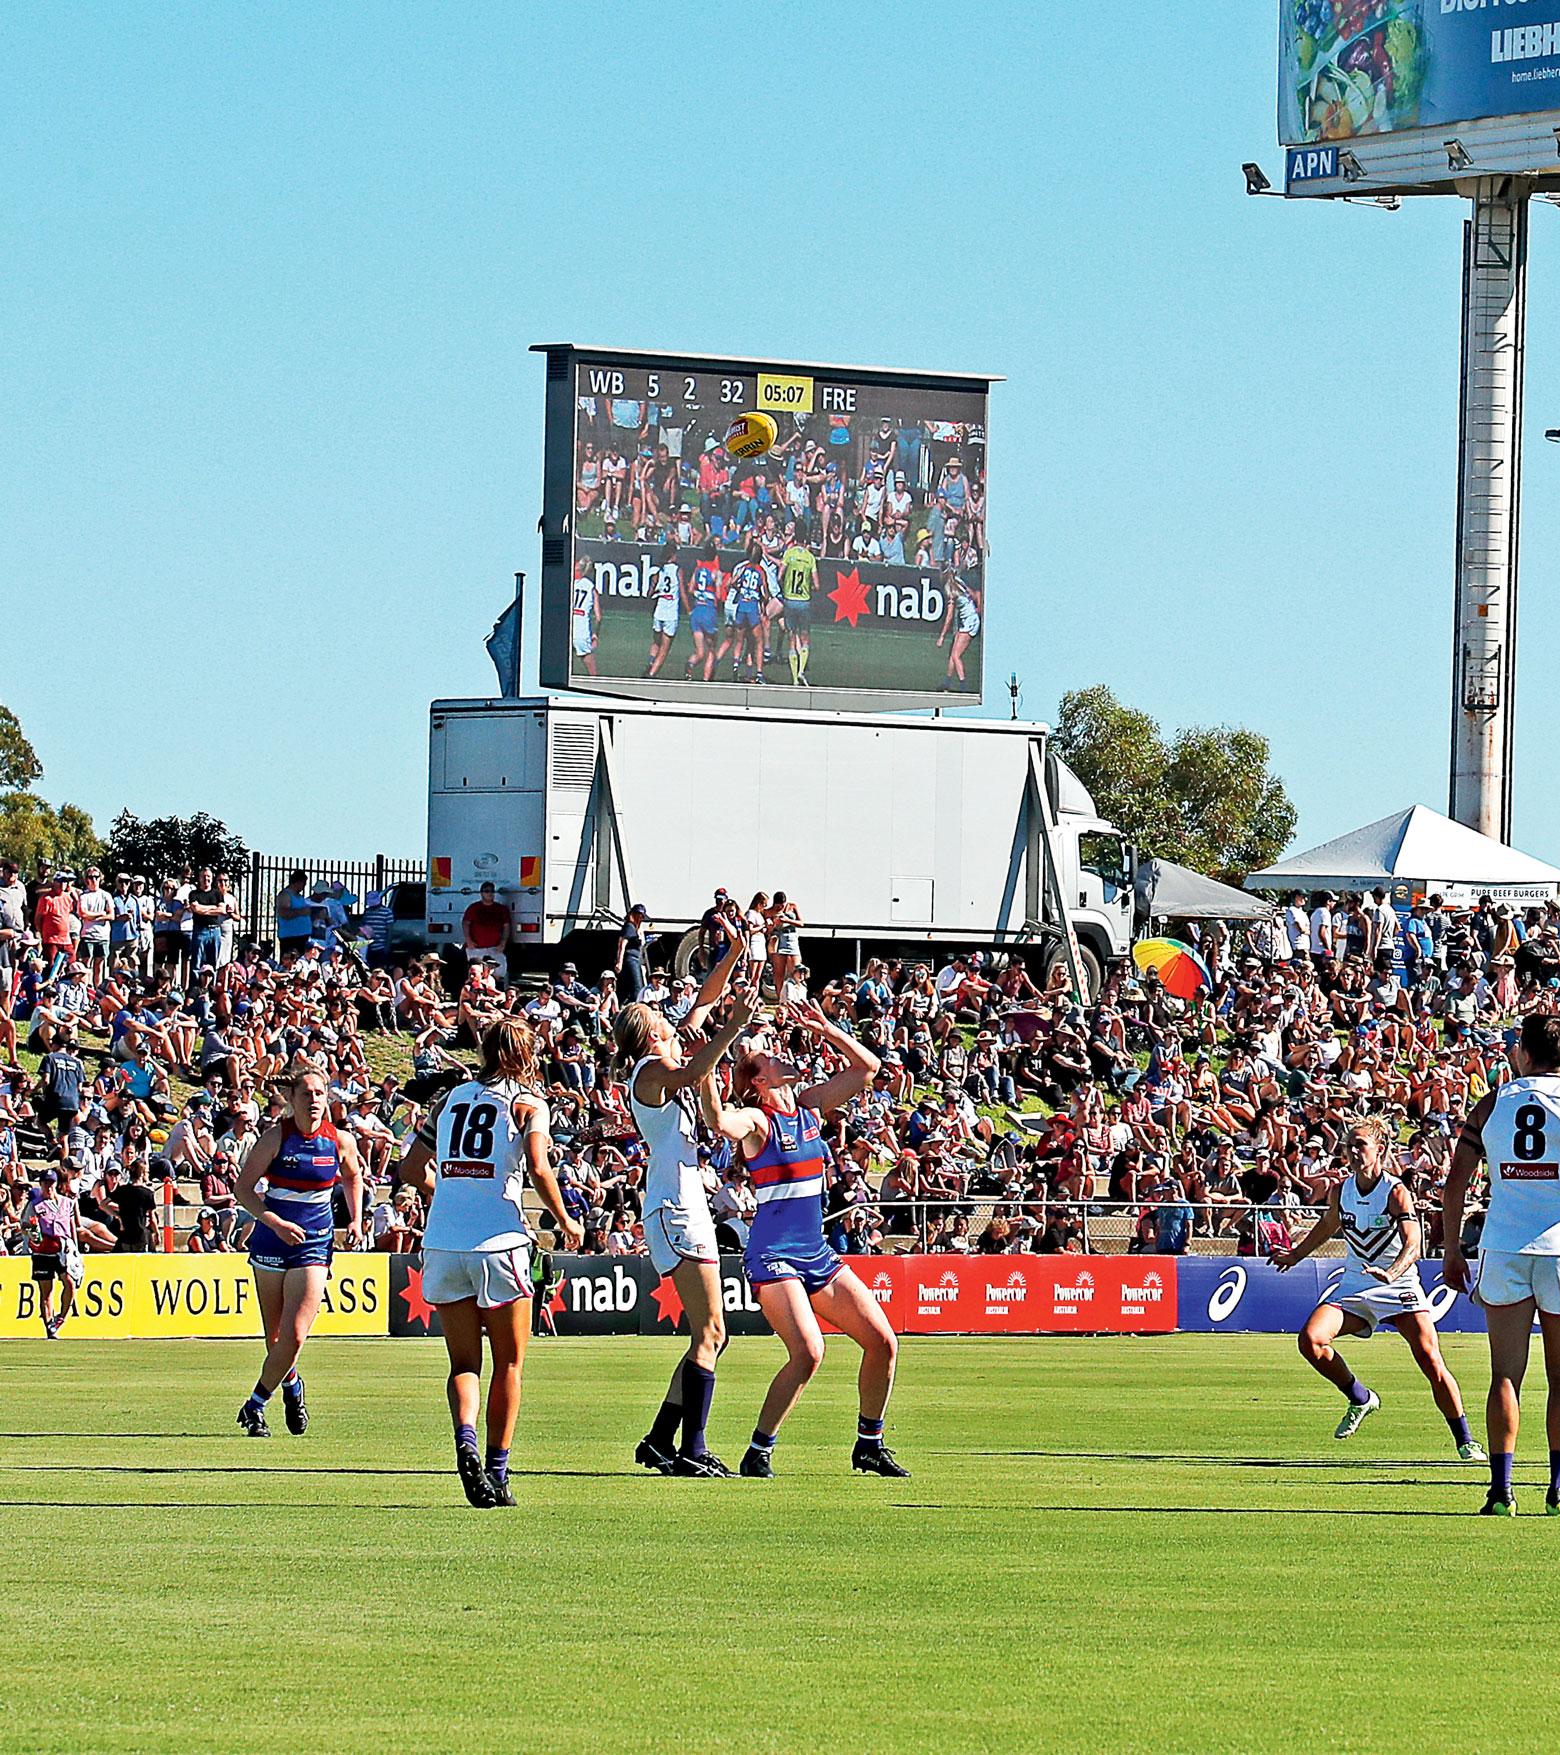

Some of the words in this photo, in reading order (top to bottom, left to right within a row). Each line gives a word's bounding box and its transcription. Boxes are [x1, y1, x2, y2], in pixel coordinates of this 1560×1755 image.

[1292, 150, 1332, 178] APN
[589, 370, 625, 395] WB
[647, 374, 660, 397] 5
[683, 377, 696, 400] 2
[720, 380, 744, 404] 32
[764, 383, 804, 404] 05:07
[822, 387, 857, 412] FRE
[663, 577, 671, 593] 3
[698, 569, 706, 591] 5
[743, 569, 759, 589] 36
[575, 589, 588, 608] 17
[876, 577, 944, 622] nab
[1471, 888, 1491, 897] PURE
[1493, 889, 1512, 897] BEEF
[1514, 889, 1549, 898] BURGERS
[448, 1102, 498, 1159] 18
[1513, 1104, 1547, 1161] 8
[1516, 1168, 1555, 1177] Woodside
[570, 1265, 638, 1312] nab
[918, 1283, 959, 1302] Powercor
[986, 1283, 1027, 1302] Powercor
[1053, 1283, 1095, 1302] Powercor
[1121, 1283, 1163, 1302] Powercor
[16, 1280, 124, 1320] BSS
[151, 1278, 249, 1315] WOLF
[319, 1278, 377, 1313] ASS
